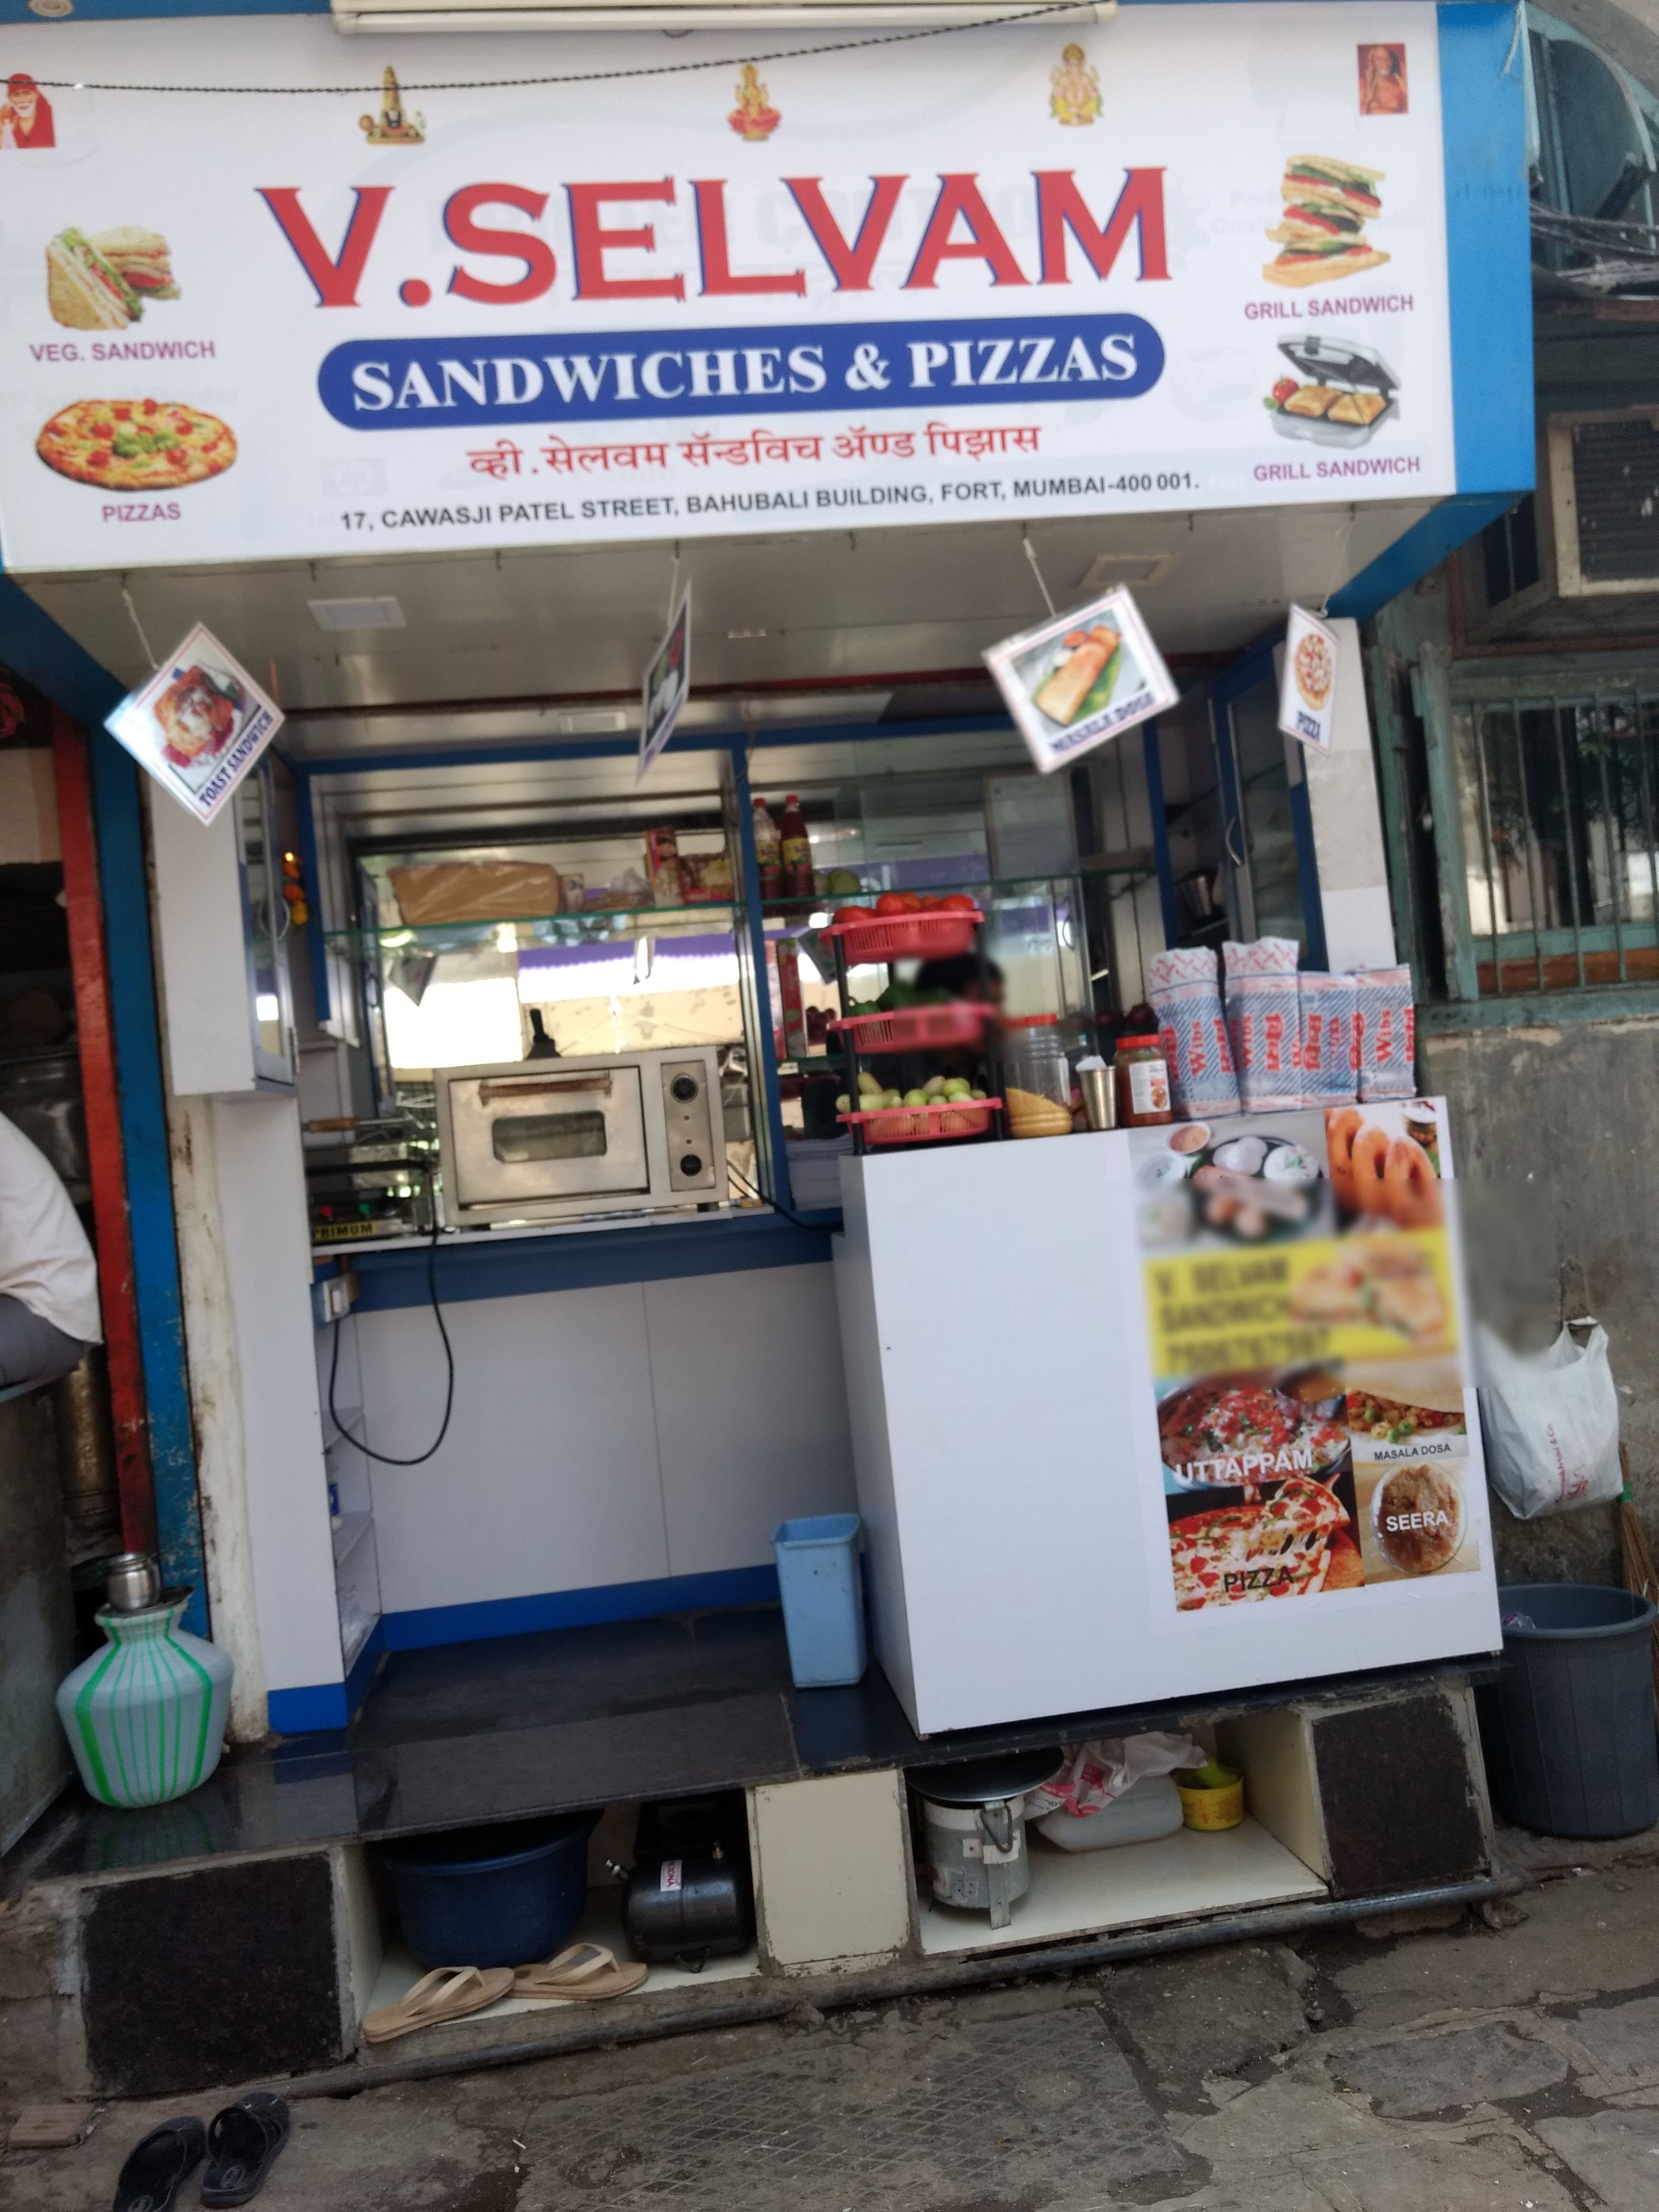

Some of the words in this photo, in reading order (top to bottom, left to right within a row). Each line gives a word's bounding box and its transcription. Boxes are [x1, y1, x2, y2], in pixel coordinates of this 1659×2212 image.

[1244, 301, 1302, 321] GRILL
[1308, 294, 1415, 317] SANDWICH
[29, 343, 85, 363] VEG.
[92, 340, 216, 361] SANDWICH
[352, 344, 828, 411] SANDWICHES
[844, 343, 891, 391] &
[907, 333, 1139, 389] PIZZAS
[922, 420, 1041, 462] पिझास
[1253, 463, 1311, 481] GRILL
[1316, 456, 1421, 479] SANDWICH
[102, 503, 181, 523] PIZZAS
[341, 513, 374, 531] 17,
[381, 505, 492, 529] CAWASJI
[499, 502, 574, 522] PATEL
[581, 497, 679, 518] STREET,
[686, 491, 809, 515] BAHUBALI
[816, 484, 934, 508] BUILDING,
[940, 481, 1007, 502] FORT,
[199, 768, 231, 807] TOAST
[227, 711, 275, 774] SANDWICH
[1189, 1021, 1207, 1077] Wibs
[1376, 1010, 1393, 1063] Wibs
[1175, 1448, 1313, 1483] UTTAPPAM
[1374, 1447, 1419, 1460] MASALA
[1421, 1443, 1452, 1455] DOSA
[1385, 1510, 1449, 1532] SEERA
[1223, 1566, 1293, 1592] PIZZA
